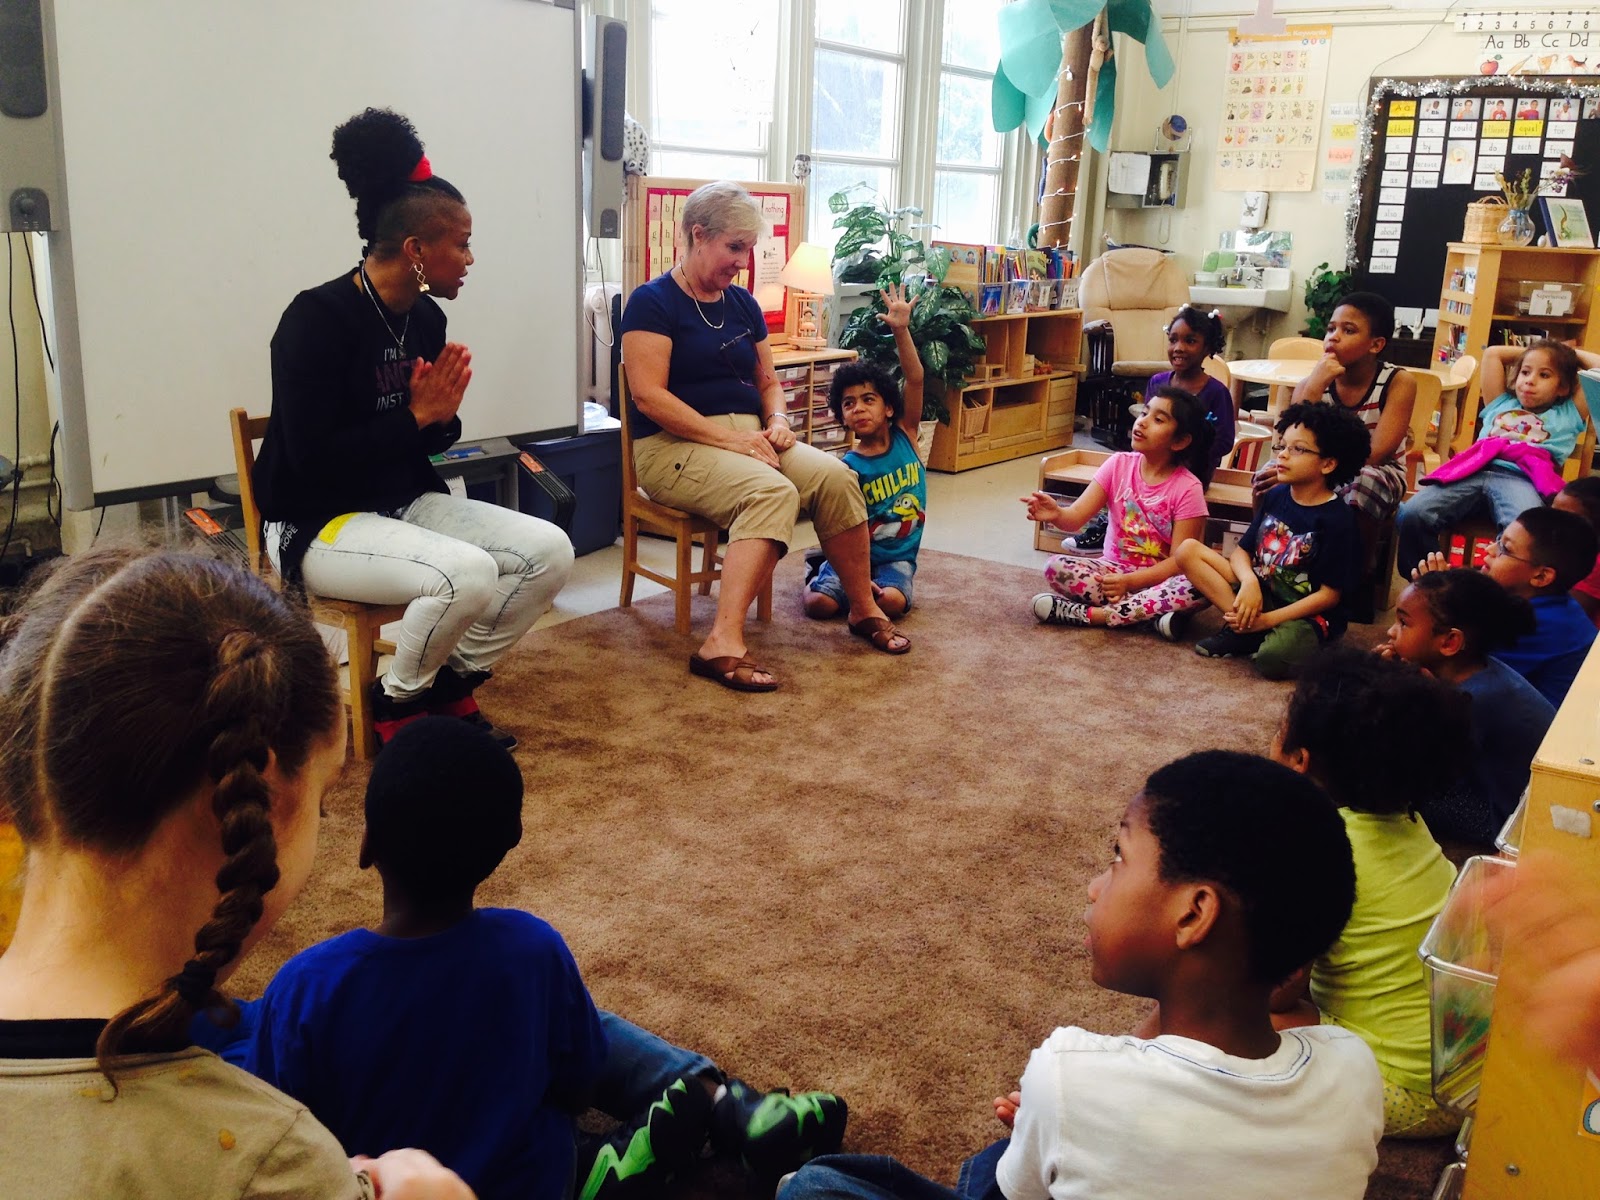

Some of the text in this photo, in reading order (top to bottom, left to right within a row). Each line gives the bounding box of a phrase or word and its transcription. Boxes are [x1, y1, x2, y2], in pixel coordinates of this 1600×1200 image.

[1462, 20, 1589, 30] 1 2 3 4 5 6 7 8
[1485, 32, 1589, 49] Aa Bb Cc Dd
[1395, 104, 1411, 112] Aa
[1453, 124, 1473, 132] could
[1519, 123, 1538, 136] equal
[1553, 125, 1566, 134] for
[1423, 143, 1431, 153] by
[1489, 143, 1497, 152] do
[665, 204, 670, 213] b
[765, 202, 785, 218] nothing
[666, 229, 670, 239] h
[1380, 227, 1398, 236] about
[384, 347, 397, 362] I'M
[862, 461, 920, 505] CHILLIN'
[280, 525, 299, 552] HOPE
